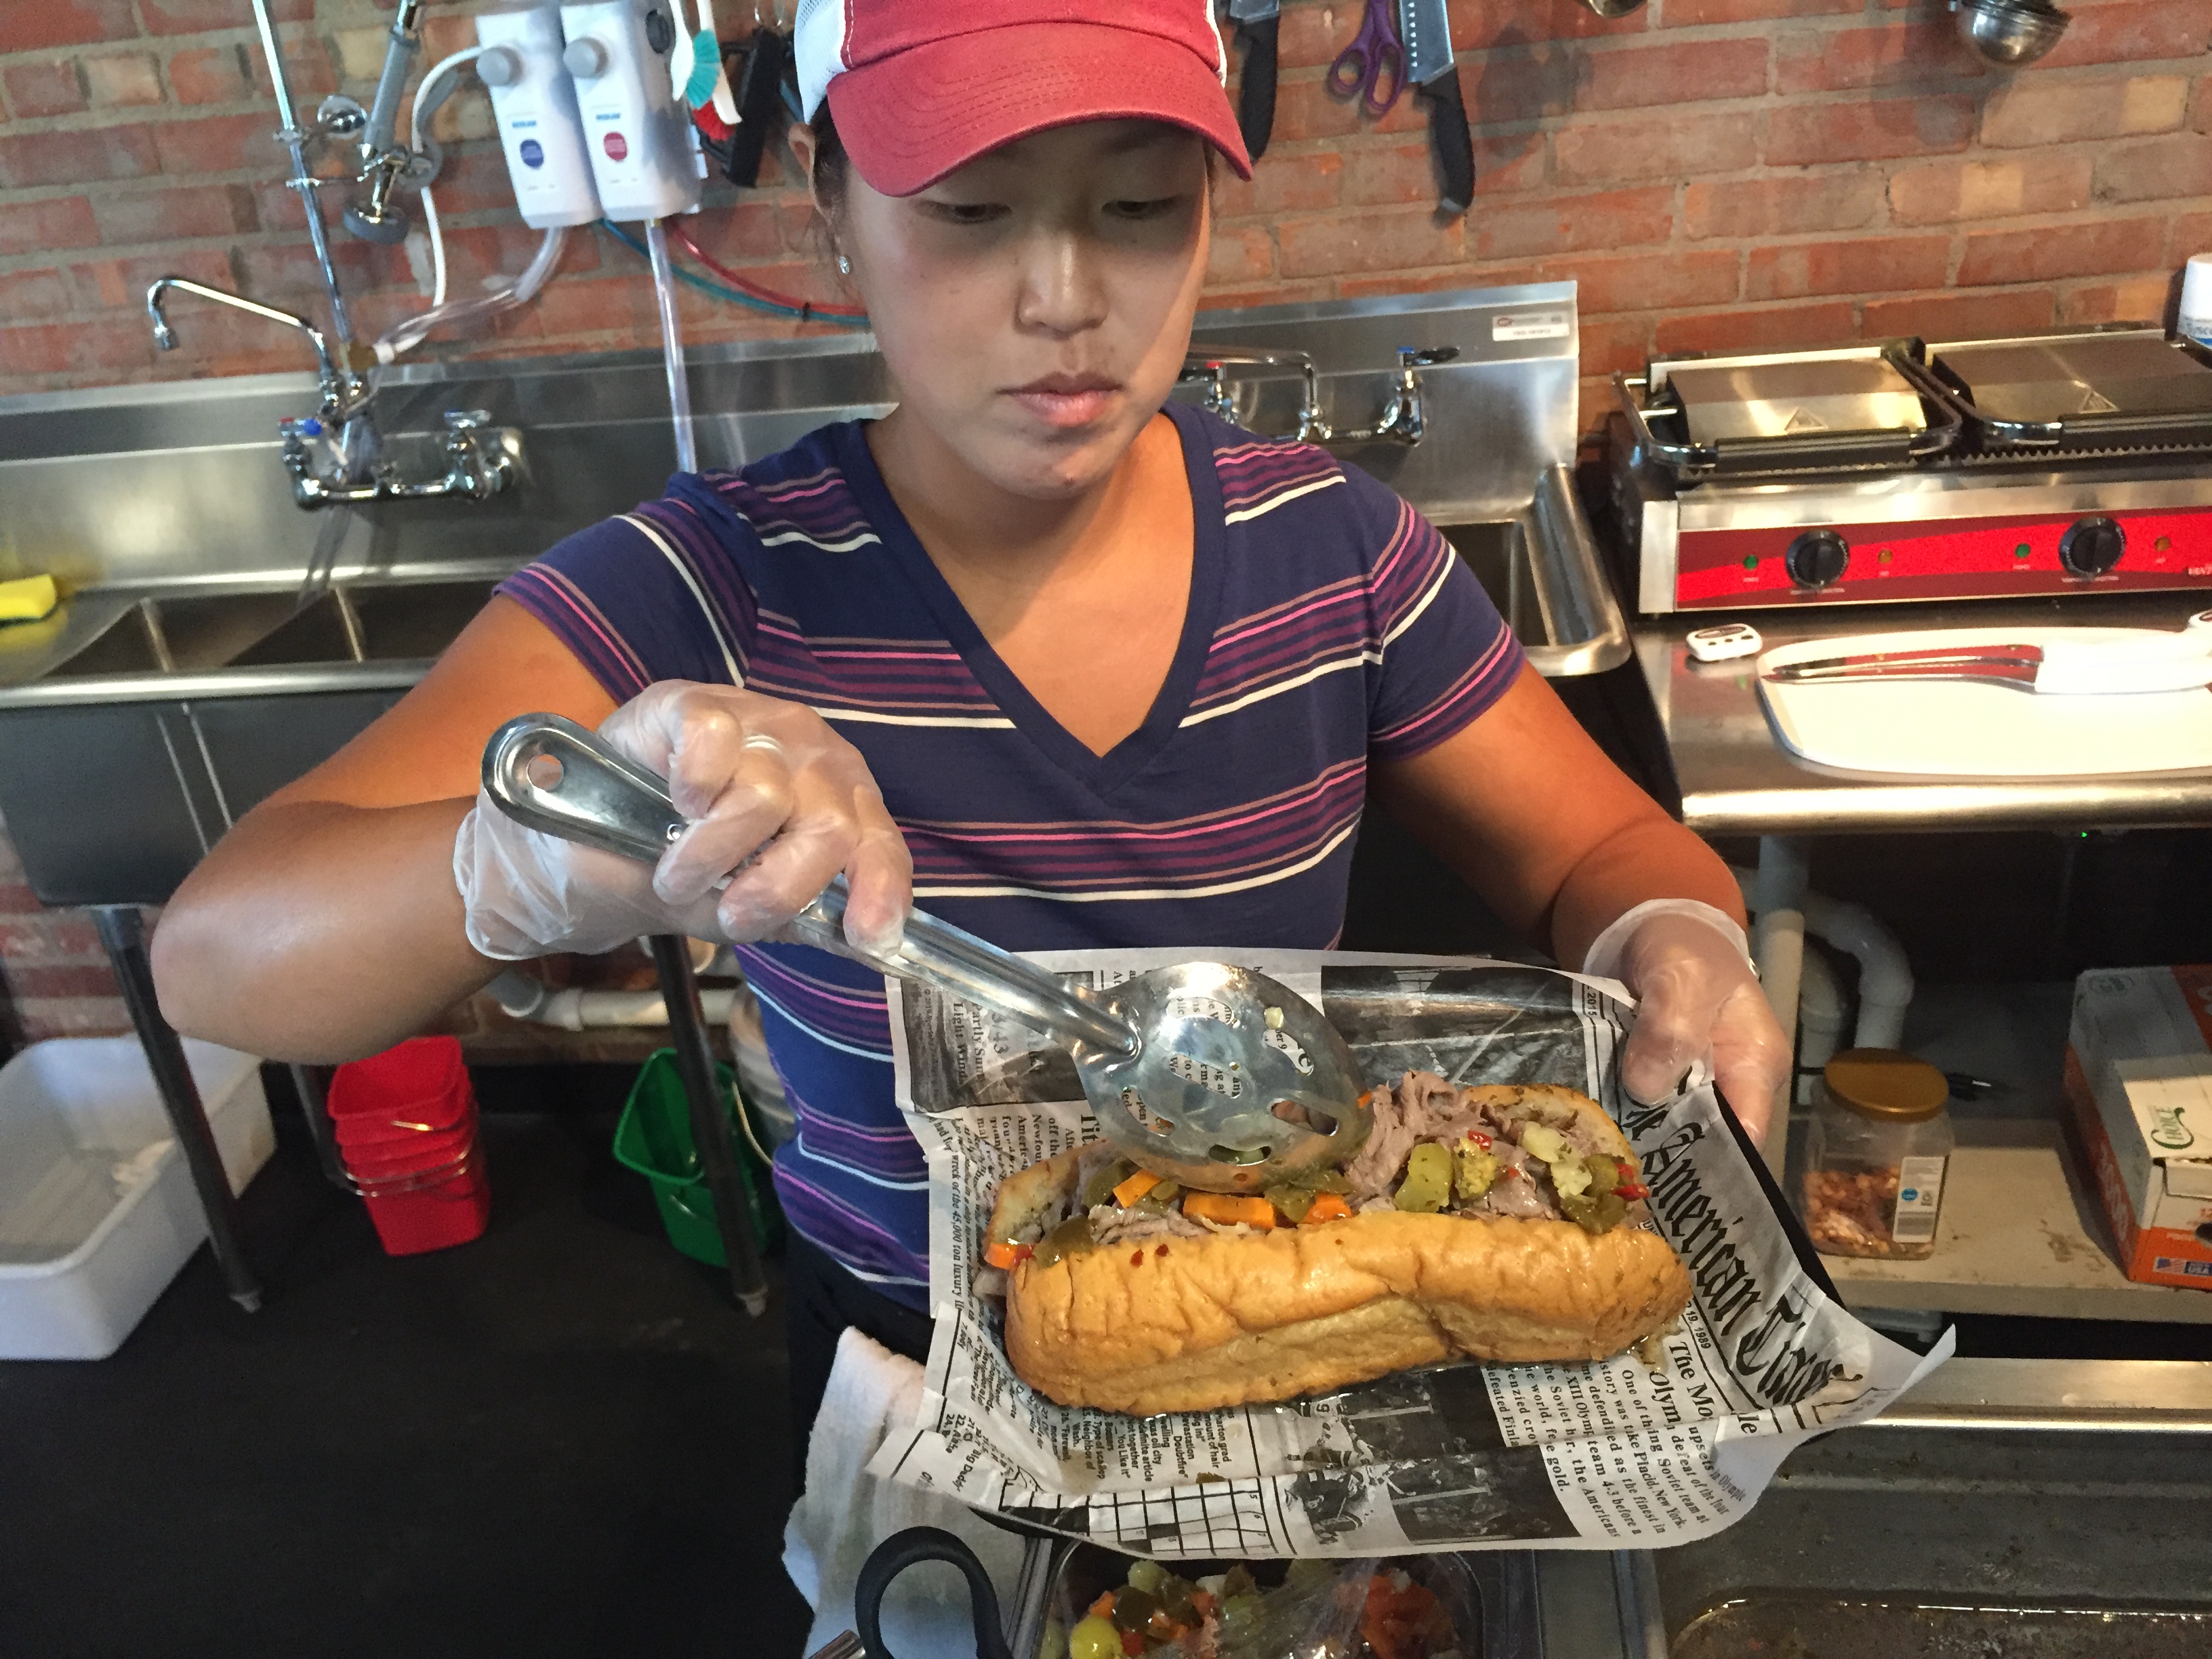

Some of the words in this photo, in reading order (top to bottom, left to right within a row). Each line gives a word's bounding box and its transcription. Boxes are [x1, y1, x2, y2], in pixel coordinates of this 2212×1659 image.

[1587, 992, 1598, 1016] 2015
[951, 1003, 964, 1039] Light
[1048, 1118, 1060, 1136] off
[951, 1155, 963, 1179] wreck
[951, 1181, 961, 1193] of
[952, 1193, 962, 1208] the
[950, 1210, 962, 1242] 45,000
[1639, 1122, 1761, 1337] American
[952, 1244, 962, 1261] ton
[951, 1263, 964, 1296] luxury
[1694, 1327, 1712, 1349] 1989
[1668, 1340, 1697, 1380] The
[1565, 1375, 1585, 1400] XIII
[1622, 1370, 1637, 1395] One
[1633, 1399, 1648, 1412] of
[1530, 1384, 1553, 1424] world,
[1549, 1385, 1574, 1423] Soviet
[1614, 1399, 1629, 1420] was
[1082, 1420, 1094, 1459] Neighbor
[1092, 1421, 1103, 1439] Type
[1117, 1434, 1126, 1450] You
[1151, 1437, 1161, 1449] oil
[1118, 1450, 1128, 1467] Like
[1127, 1433, 1141, 1470] together
[1150, 1450, 1163, 1466] city
[1209, 1441, 1218, 1450] of
[1210, 1450, 1221, 1469] hair
[1219, 1442, 1232, 1462] grad
[1688, 1426, 1716, 1471] upsets
[1143, 1456, 1153, 1483] article
[1547, 1457, 1570, 1492] gold.
[1587, 1440, 1605, 1476] team
[1601, 1481, 1620, 1496] 4-3
[1612, 1498, 1637, 1527] before
[1633, 1452, 1659, 1490] Placid,
[1652, 1488, 1672, 1507] New
[1671, 1435, 1697, 1476] defeat
[1690, 1478, 1706, 1488] of
[1698, 1488, 1716, 1500] the
[1710, 1498, 1731, 1515] four
[1572, 1458, 1588, 1483] the
[1581, 1488, 1621, 1538] Americans
[1613, 1457, 1628, 1474] as
[1622, 1478, 1639, 1494] the
[1633, 1496, 1660, 1522] finest
[1653, 1524, 1666, 1534] in
[1657, 1458, 1685, 1492] Soviet
[1679, 1494, 1700, 1514] team
